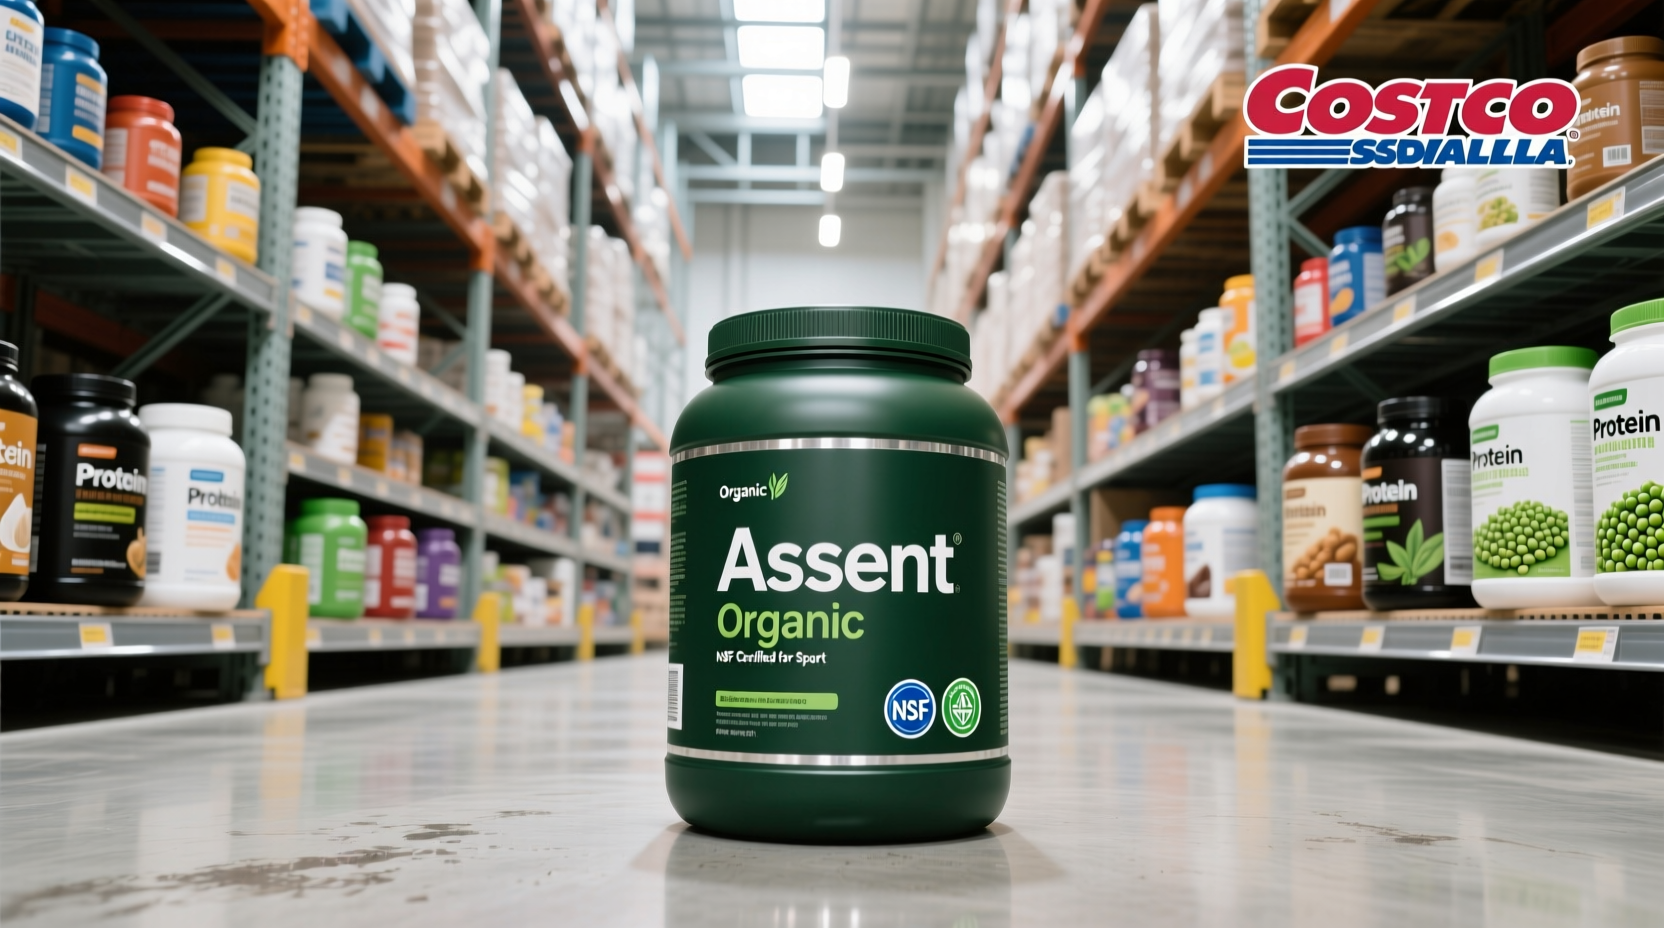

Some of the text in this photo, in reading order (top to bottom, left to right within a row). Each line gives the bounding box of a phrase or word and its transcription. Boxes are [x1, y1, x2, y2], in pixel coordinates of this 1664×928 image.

[1593, 409, 1661, 442] Protein
[719, 482, 768, 502] Organic
[716, 526, 955, 594] Assent
[717, 602, 865, 649] Organic
[892, 698, 930, 721] NSF
